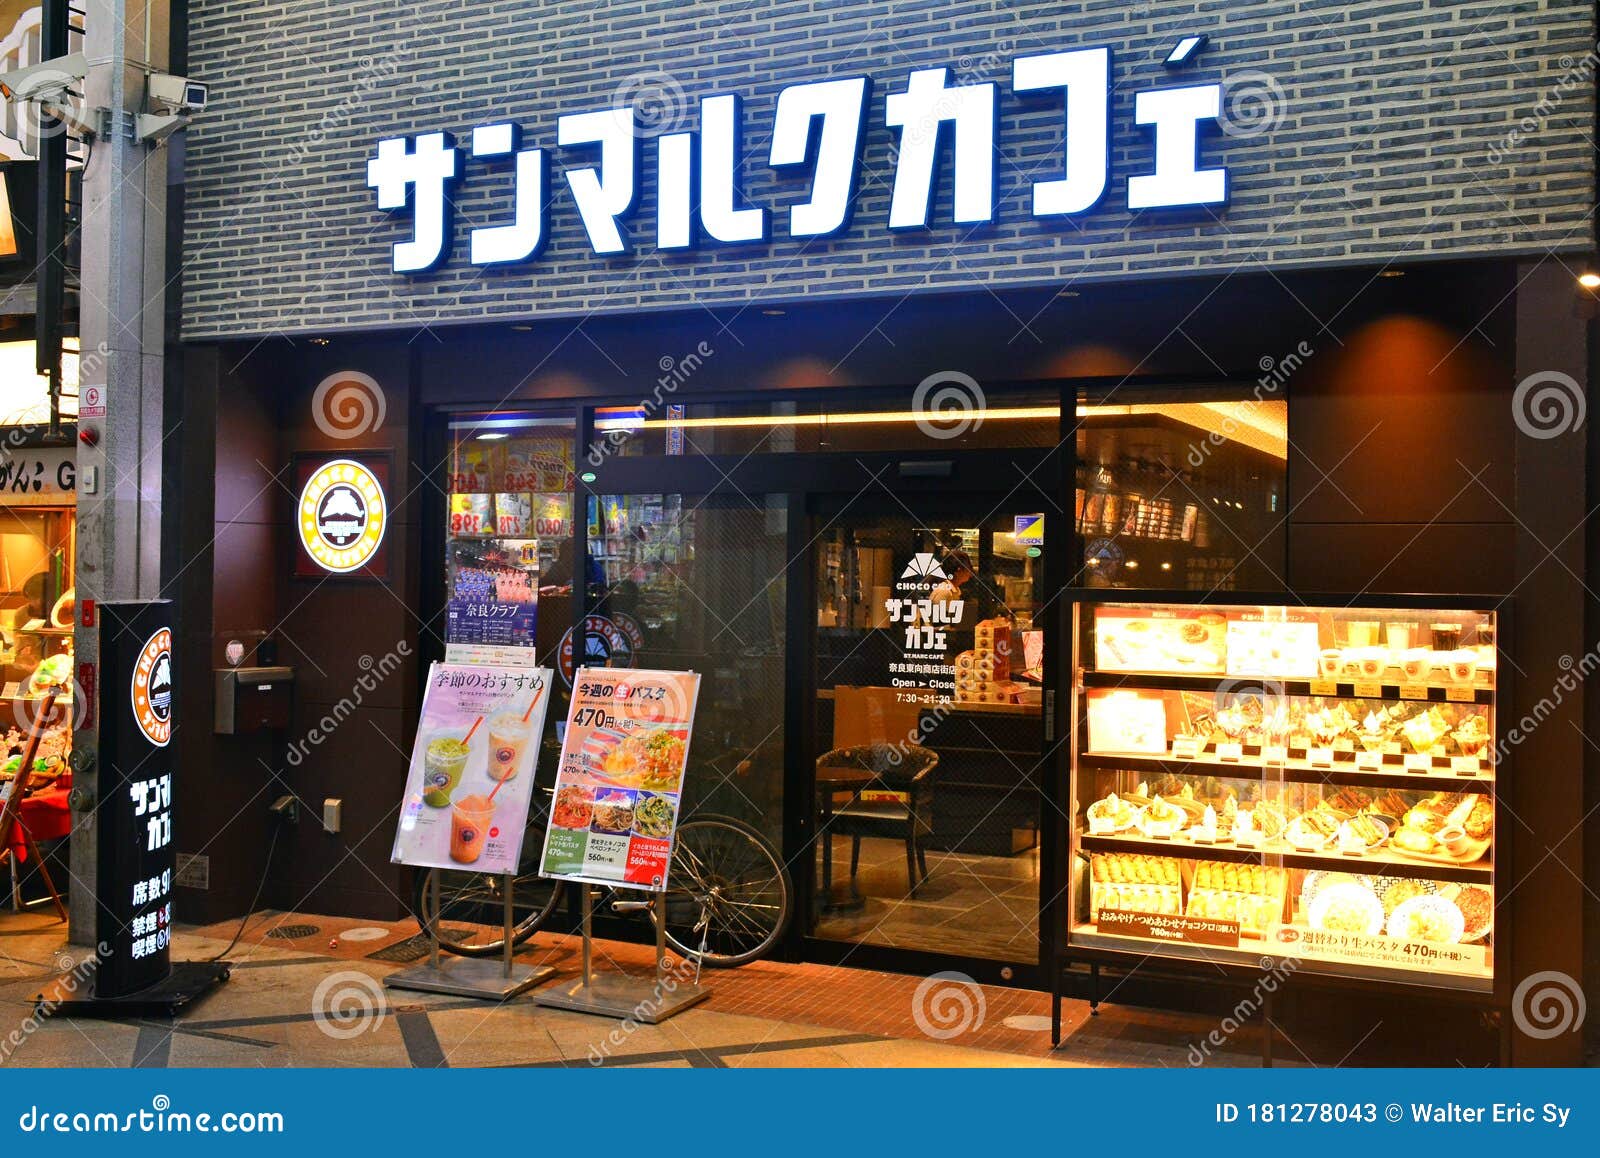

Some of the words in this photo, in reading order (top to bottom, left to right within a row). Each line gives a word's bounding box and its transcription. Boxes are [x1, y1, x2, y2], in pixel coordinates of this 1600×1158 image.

[466, 603, 519, 617] 奈良クラブ
[885, 599, 964, 623] サンマルク
[905, 626, 947, 650] カフェ
[437, 671, 544, 691] 季節のおすすめ
[892, 677, 915, 688] Open
[929, 679, 956, 689] Close
[579, 682, 666, 701] 今週の生パスタ
